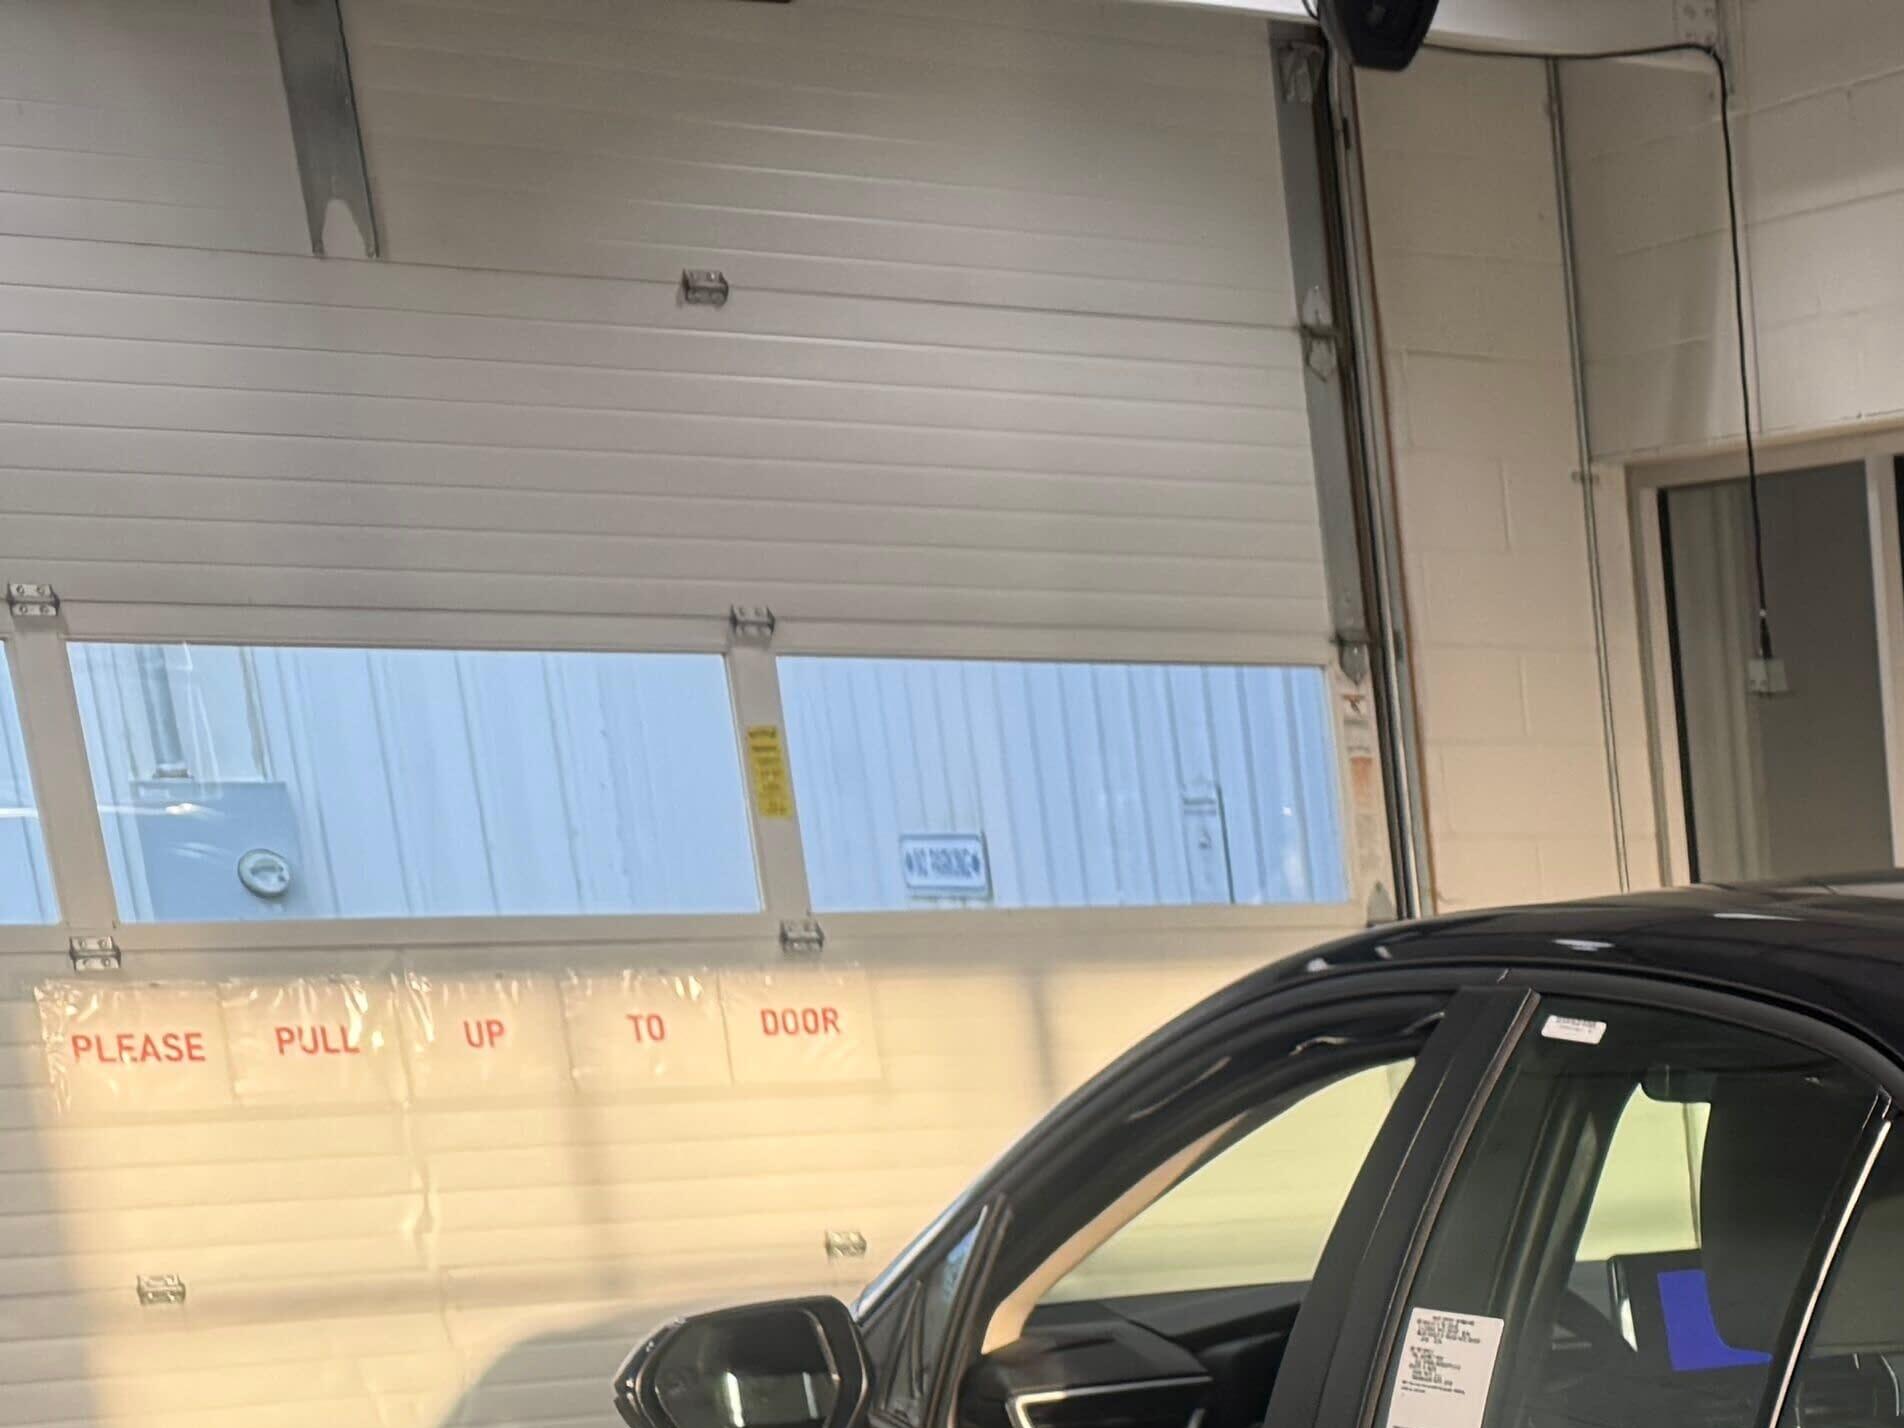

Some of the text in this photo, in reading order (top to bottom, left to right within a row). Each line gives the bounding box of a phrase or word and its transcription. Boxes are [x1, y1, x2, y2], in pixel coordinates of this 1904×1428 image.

[71, 1006, 841, 1063] PLEASE PULL UP TO DOOR
